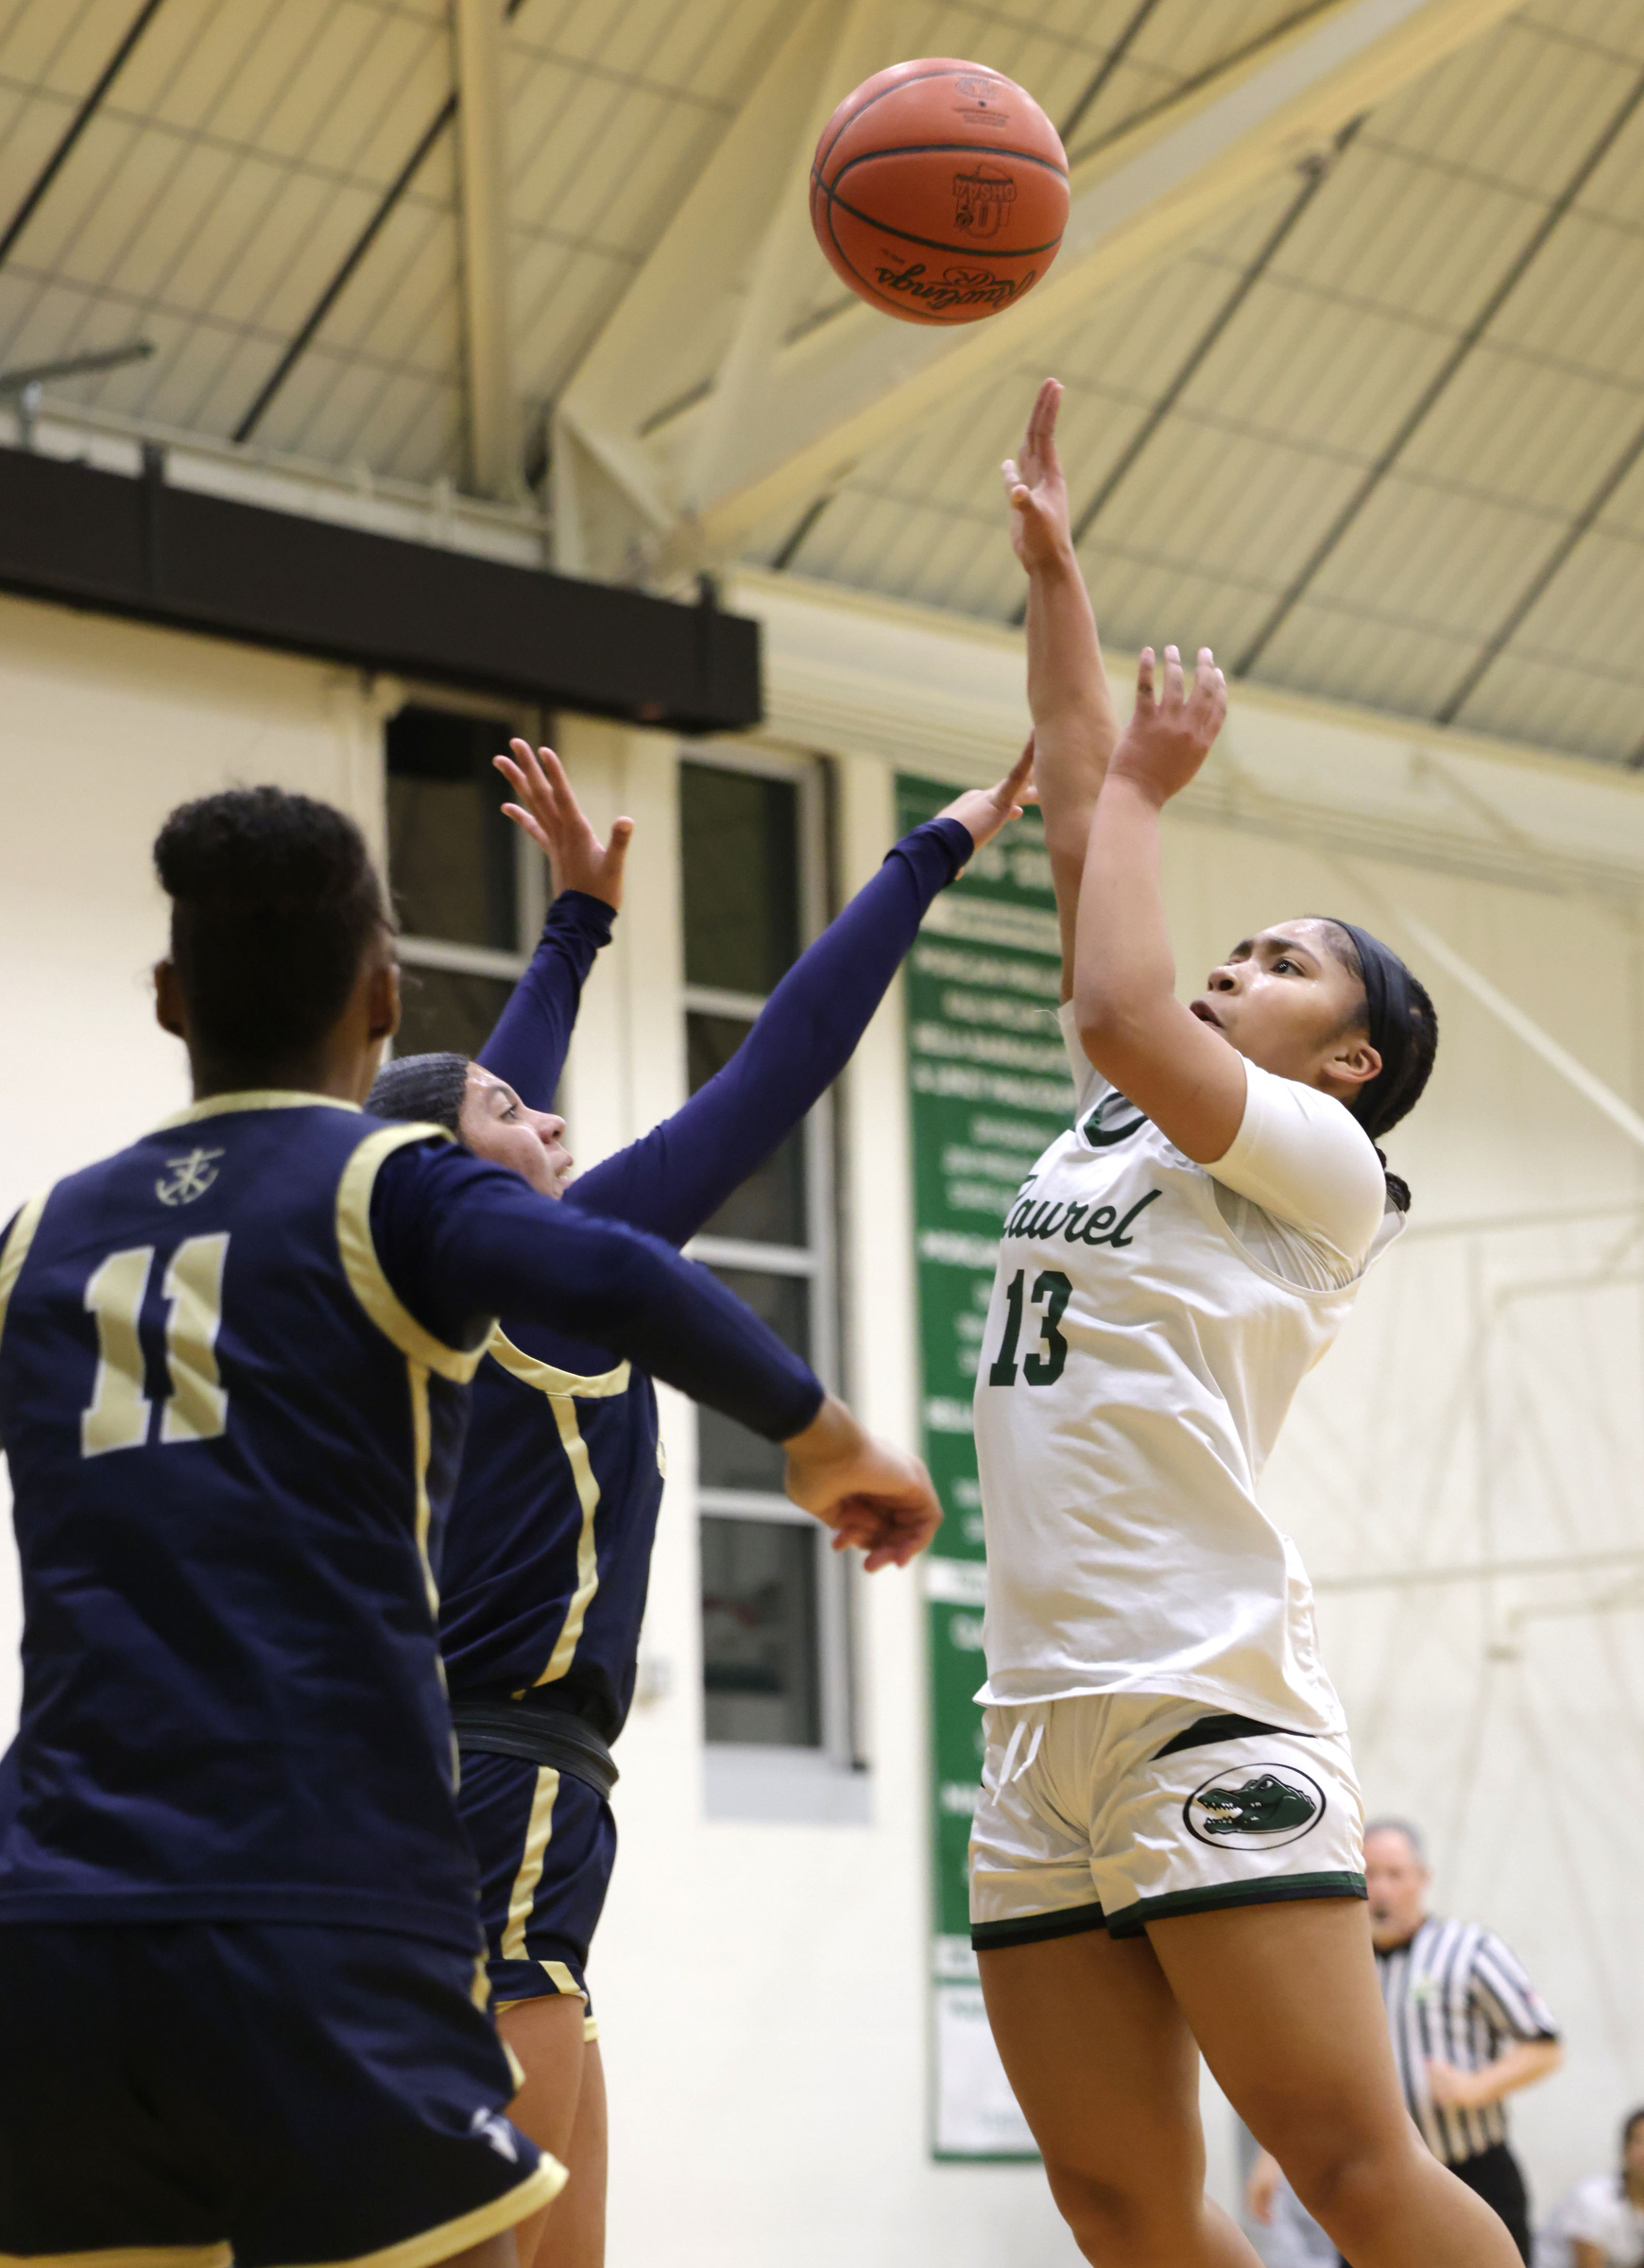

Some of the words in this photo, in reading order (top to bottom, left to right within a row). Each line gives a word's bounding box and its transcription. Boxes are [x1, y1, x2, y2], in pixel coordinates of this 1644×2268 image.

[875, 264, 1037, 310] Rawlings
[80, 1231, 231, 1459] 11
[989, 1269, 1073, 1386] 13
